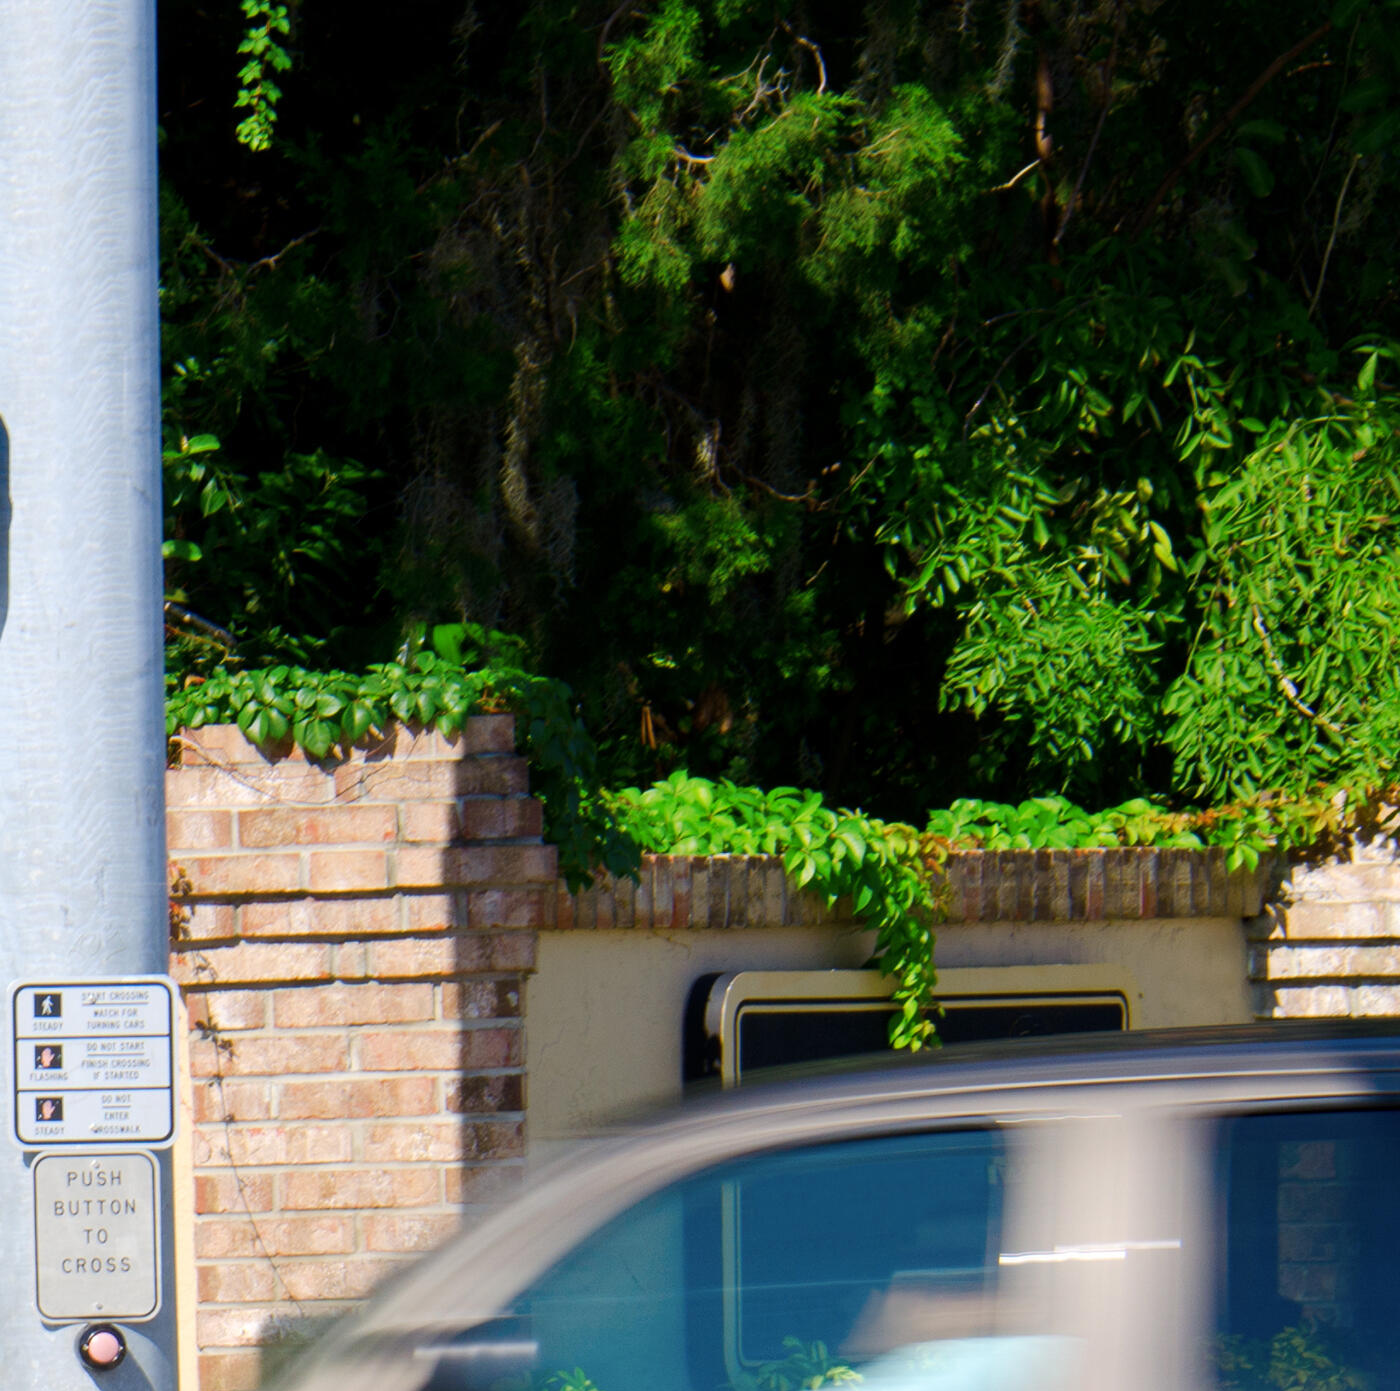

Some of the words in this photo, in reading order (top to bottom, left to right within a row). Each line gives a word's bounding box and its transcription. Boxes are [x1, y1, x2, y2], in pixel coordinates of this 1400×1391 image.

[33, 1022, 63, 1031] STEADY
[87, 1043, 98, 1051] DO
[30, 1072, 69, 1081] FLASHING
[105, 1071, 139, 1080] STARTED
[102, 1095, 112, 1104] DO
[115, 1094, 131, 1103] NOT
[104, 1112, 129, 1120] ENTER
[35, 1126, 64, 1135] STEADY
[67, 1171, 122, 1187] PUSH
[54, 1200, 136, 1216] BUTTON
[83, 1229, 108, 1244] TO
[62, 1257, 131, 1274] CROSS
